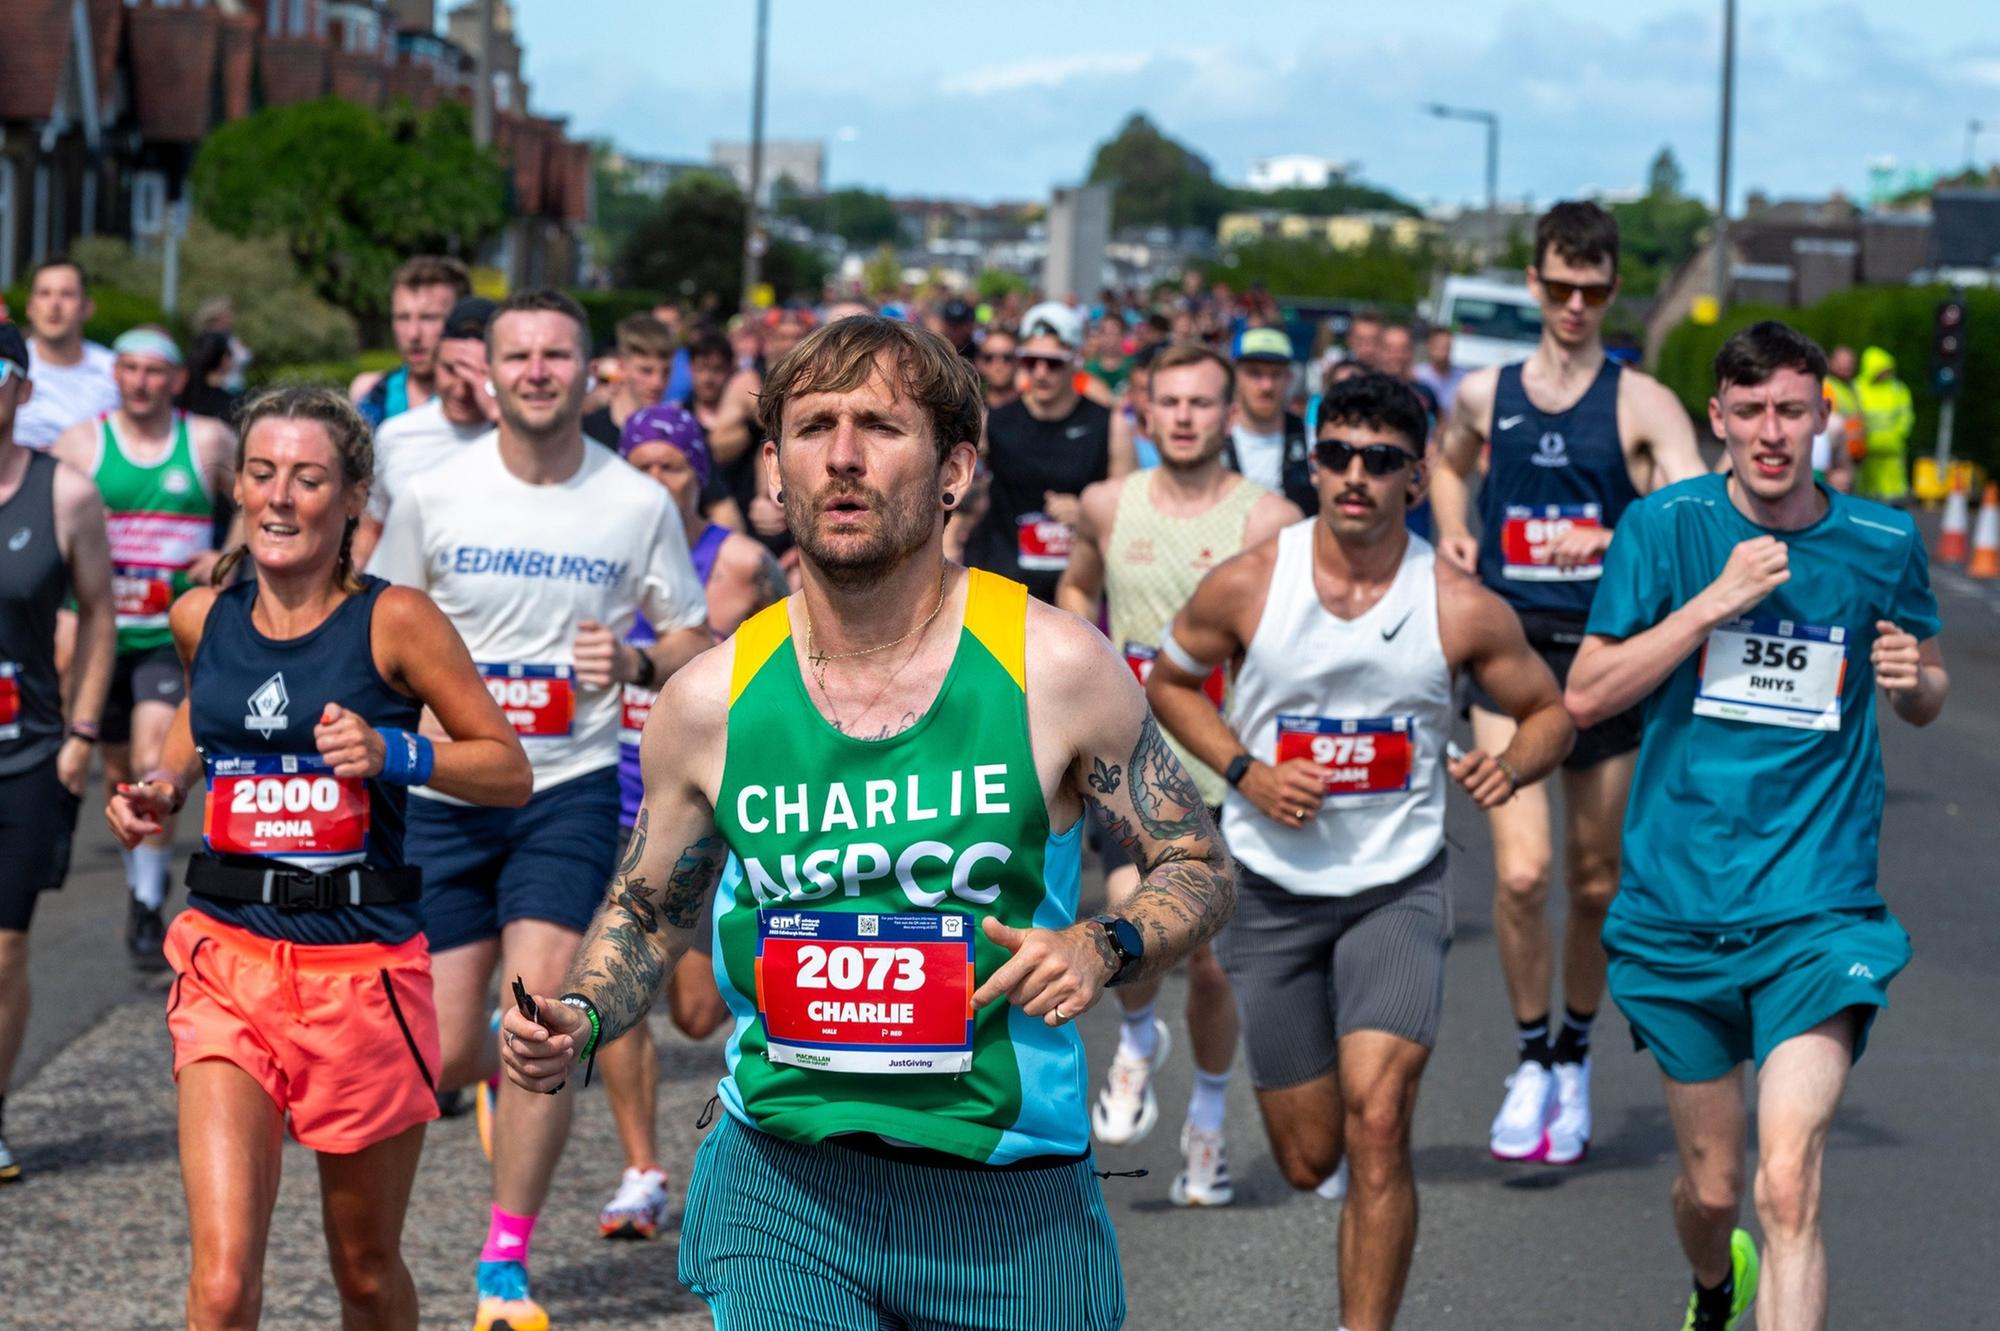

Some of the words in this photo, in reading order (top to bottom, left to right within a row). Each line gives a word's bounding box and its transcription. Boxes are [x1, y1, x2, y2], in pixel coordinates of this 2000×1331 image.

[454, 547, 630, 587] EDINBURGH
[1742, 638, 1808, 672] 356
[1750, 676, 1795, 692] RHYS
[1310, 735, 1377, 765] 975
[231, 777, 340, 814] 2000
[737, 764, 1011, 834] CHARLIE
[255, 820, 314, 837] FIONA
[743, 841, 1013, 908] NSPCC
[770, 913, 801, 929] emf
[796, 945, 926, 991] 2073
[808, 1001, 913, 1024] CHARLIE
[795, 1053, 831, 1062] MACMILLAN
[888, 1059, 933, 1068] JustGiving
